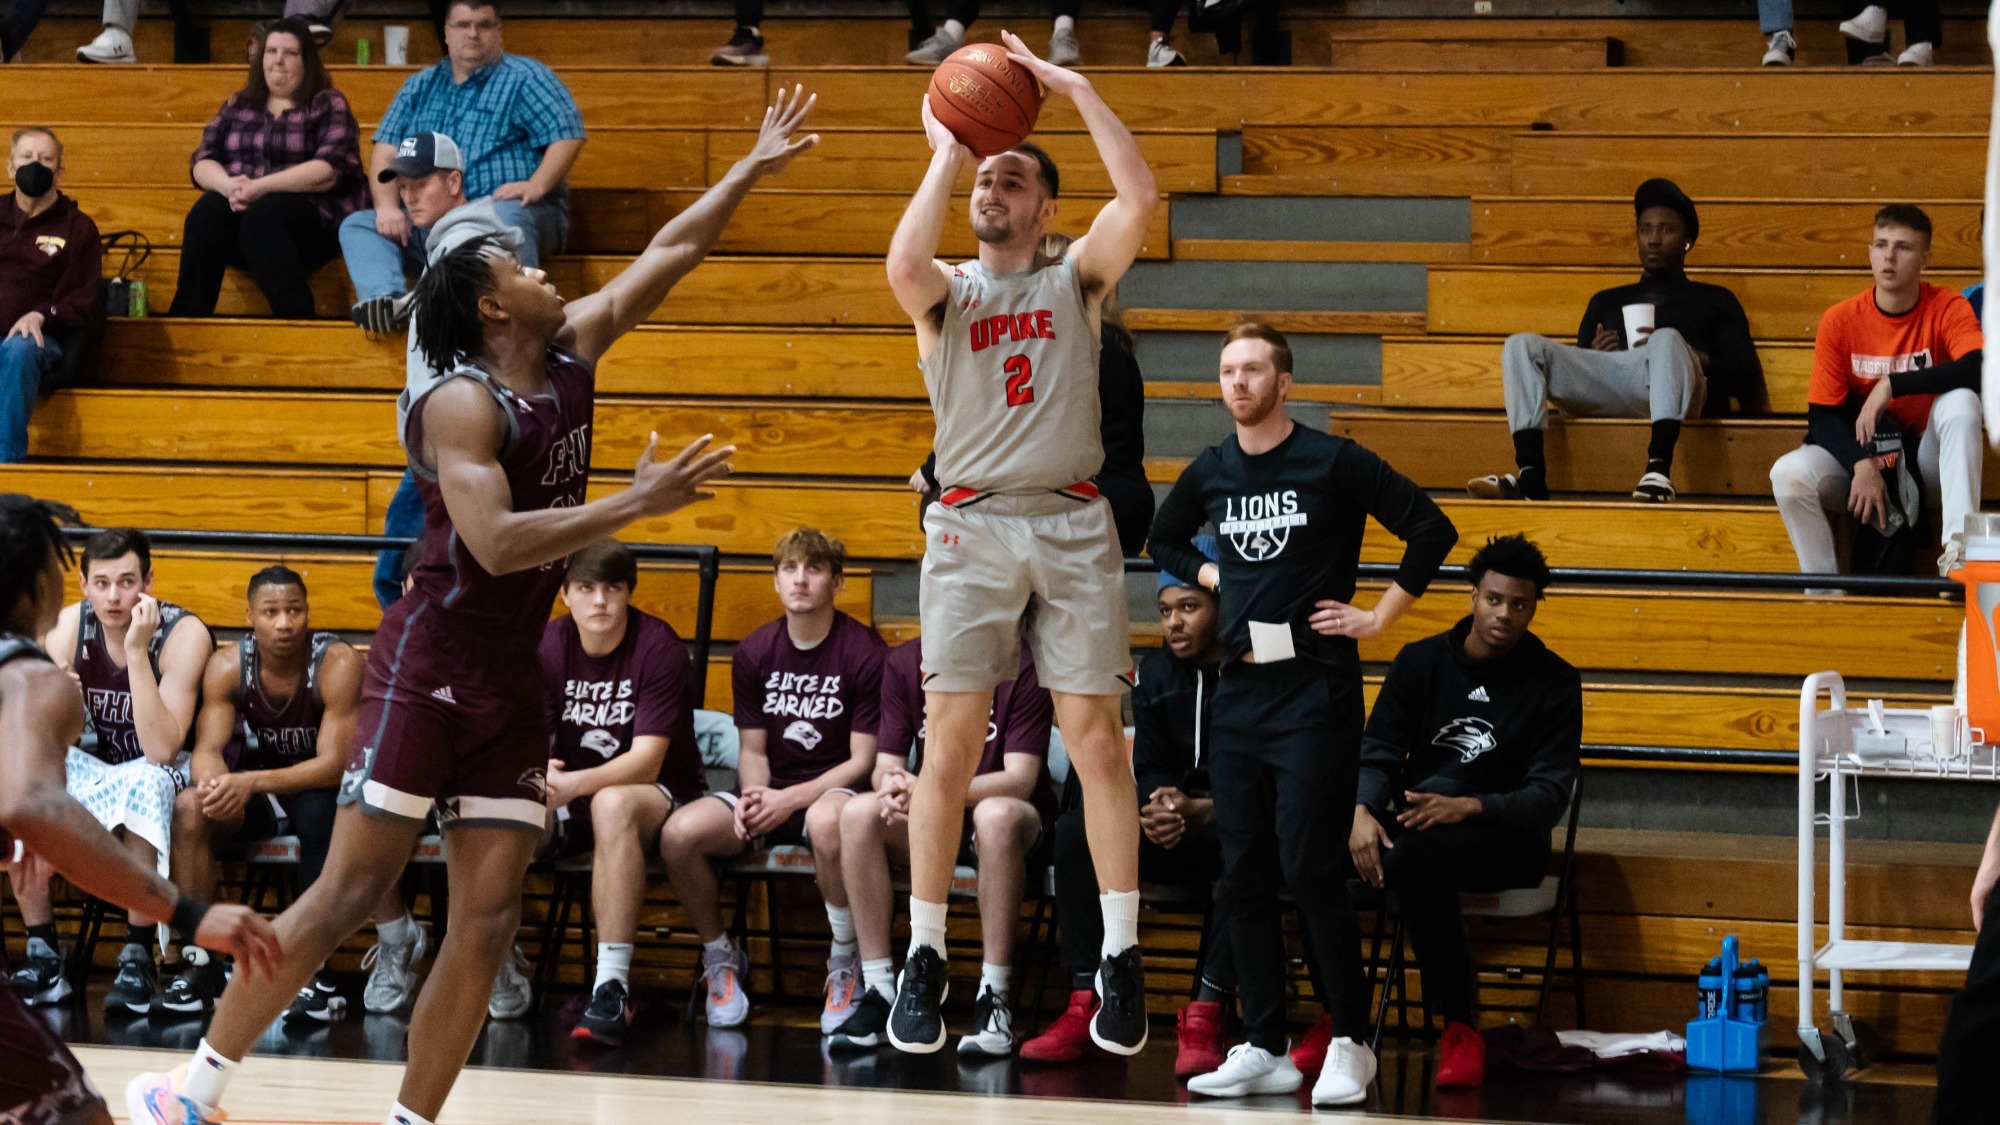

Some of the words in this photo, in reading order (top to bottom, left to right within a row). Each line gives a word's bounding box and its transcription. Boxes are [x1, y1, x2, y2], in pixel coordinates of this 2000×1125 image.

[949, 69, 1004, 110] LEGACY
[970, 309, 1056, 352] UPIKE
[1003, 353, 1035, 408] 2
[1226, 490, 1298, 522] LIONS
[565, 679, 613, 701] ELITE
[615, 679, 633, 698] IS
[765, 671, 819, 693] ELITE
[820, 675, 840, 694] IS
[562, 700, 635, 727] EARNED
[762, 691, 844, 719] EARNED
